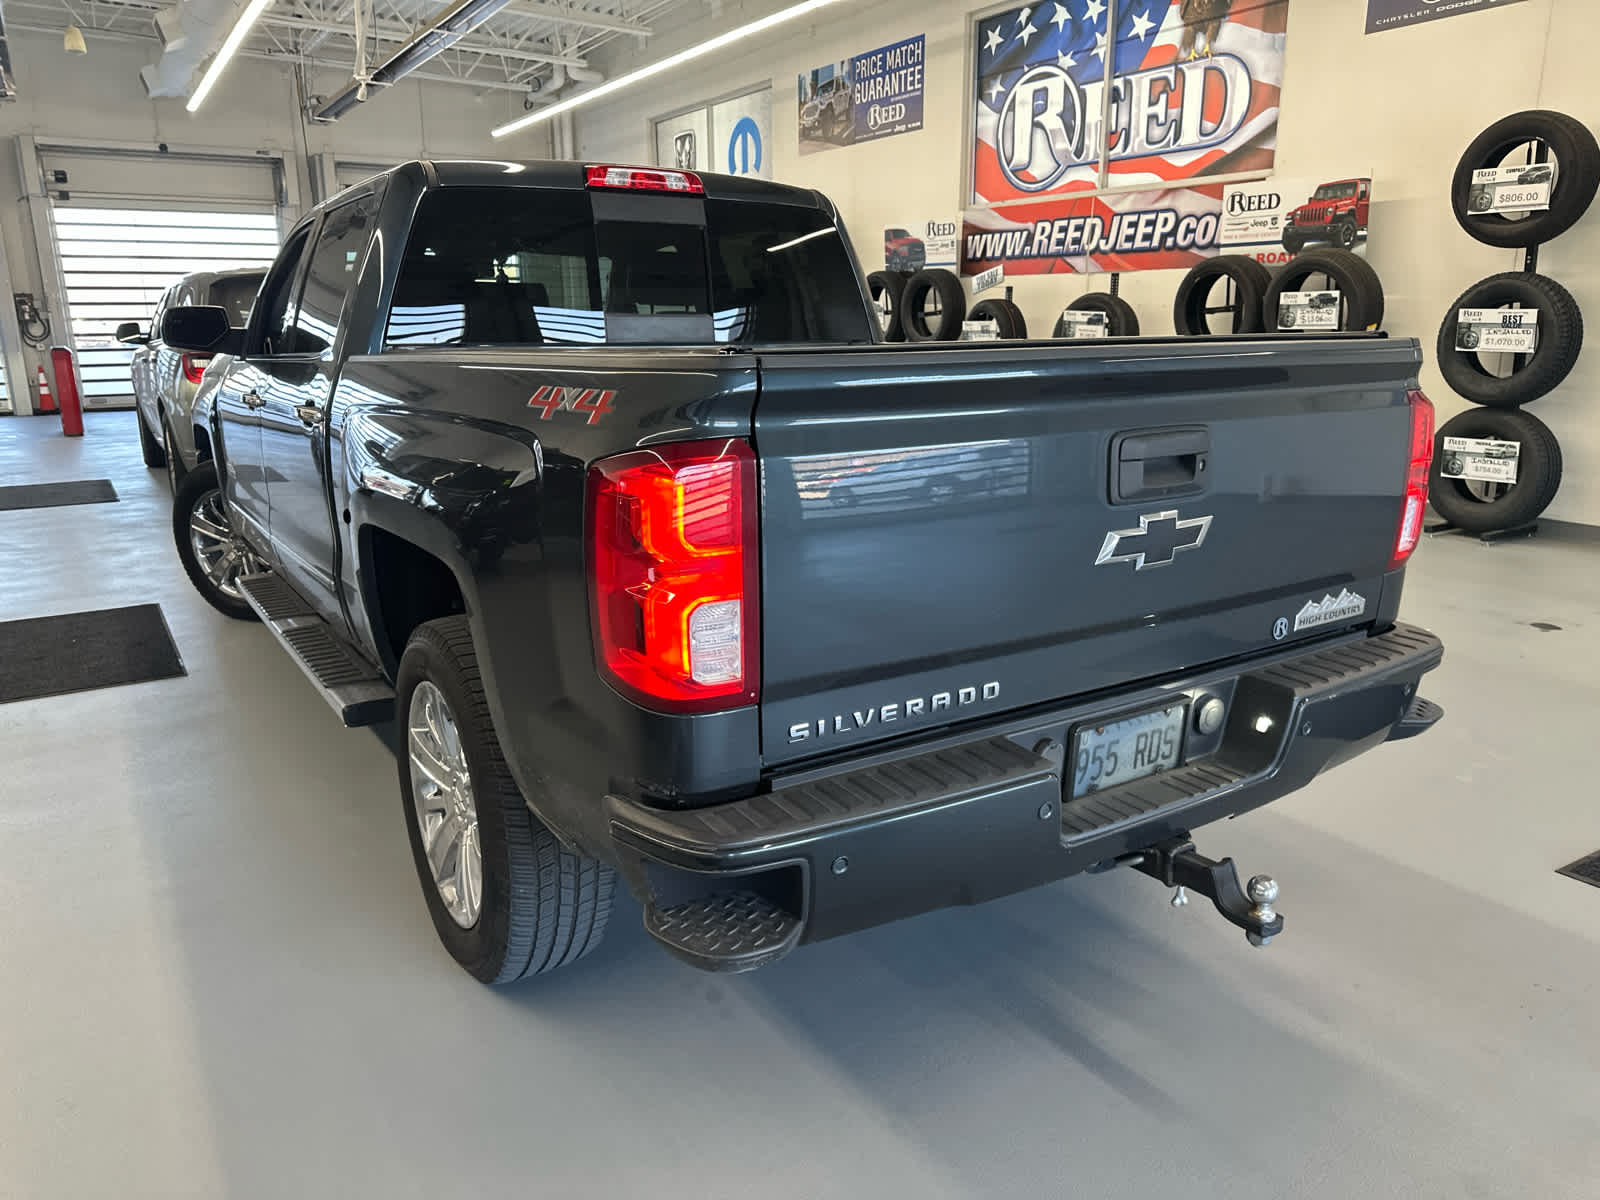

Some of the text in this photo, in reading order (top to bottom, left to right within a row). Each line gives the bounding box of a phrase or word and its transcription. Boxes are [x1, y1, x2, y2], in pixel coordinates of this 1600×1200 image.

[1376, 9, 1430, 25] CHRYSLER
[855, 41, 922, 80] PRICE MATCH
[854, 65, 922, 105] GUARANTEE
[997, 53, 1253, 193] REED
[1227, 191, 1281, 217] REED
[1499, 191, 1539, 203] $806.00
[1502, 314, 1524, 323] BEST
[1299, 604, 1362, 626] HIGH COUNTRY
[787, 680, 1001, 744] SILVERADO
[1076, 724, 1176, 786] 955 RDS
